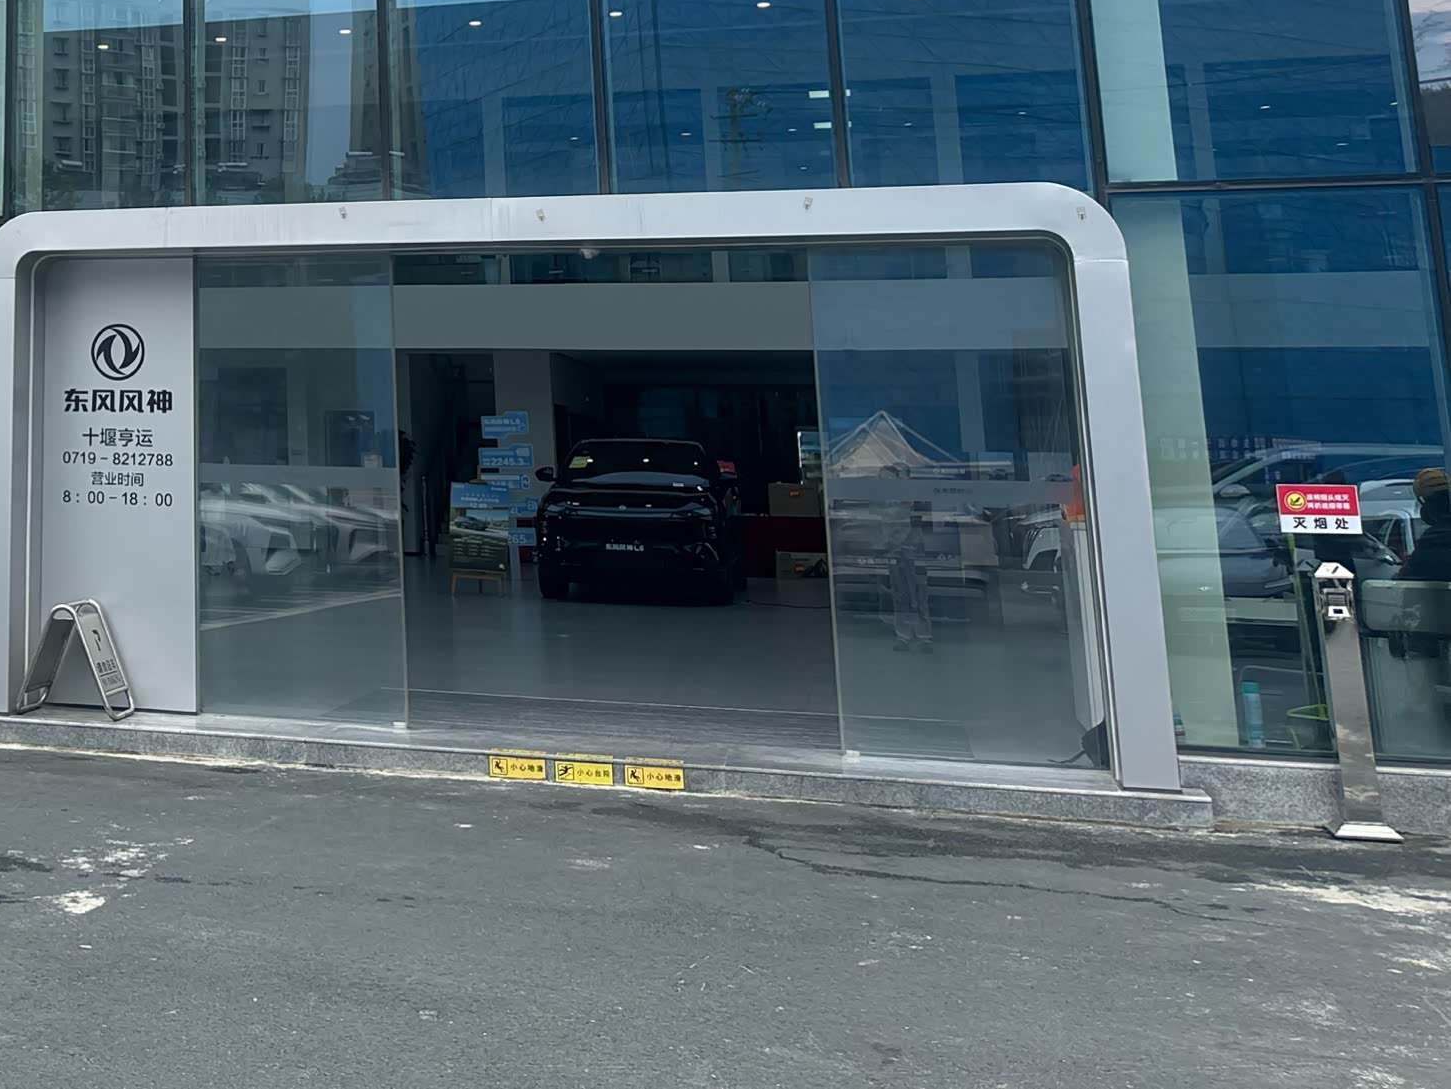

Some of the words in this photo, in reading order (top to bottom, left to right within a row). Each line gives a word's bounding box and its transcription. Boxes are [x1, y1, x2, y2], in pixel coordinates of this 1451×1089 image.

[64, 388, 173, 413] 东风风神
[82, 427, 154, 448] 十堰亨运
[90, 471, 145, 487] 营业时间
[1292, 516, 1349, 530] 灭烟处
[646, 772, 682, 782] 小心地滑
